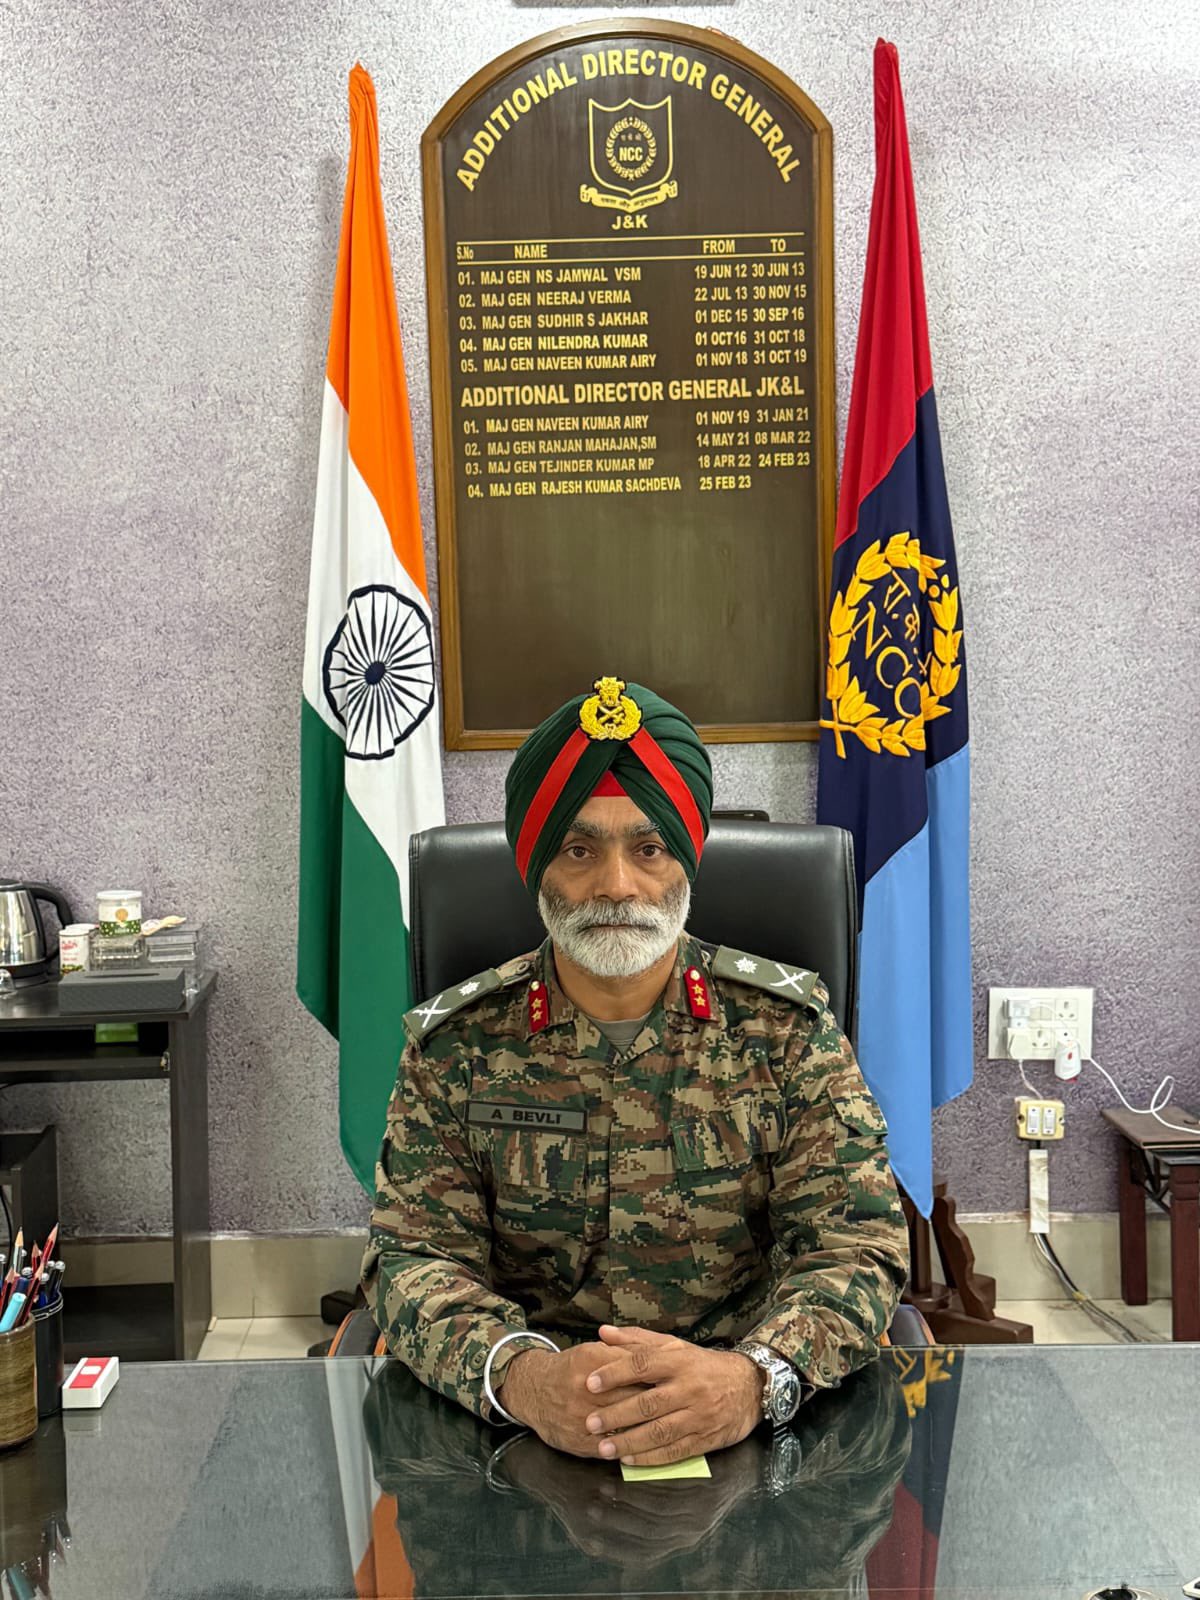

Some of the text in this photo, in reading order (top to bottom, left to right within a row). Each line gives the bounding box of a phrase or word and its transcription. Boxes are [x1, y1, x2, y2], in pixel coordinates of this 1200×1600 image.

[456, 49, 801, 191] ADDITIONAL DIRECTOR GENERAL
[620, 147, 643, 161] NCC
[611, 215, 648, 230] J&K
[514, 245, 548, 259] NAME
[703, 240, 735, 253] FROM
[771, 239, 786, 252] TO
[458, 267, 641, 285] 01. MAJ GEN NS JAMWAL VSM
[695, 262, 805, 279] 19 JUN 12 30 JUN 13
[459, 290, 632, 308] 02. MAJ GEN NEERAJ VERMA
[695, 285, 807, 301] 22 JUL 13 30 NOV 15
[460, 312, 648, 330] 03. MAJ GEN SUDHIR S JAKHAR
[695, 307, 804, 323] 01 DEC 15 30 SEP 16
[460, 334, 648, 352] 04. MAJ GEN NILENDRA KUMAR
[695, 329, 805, 346] 01 OCT 16 31 OCT 18
[461, 354, 656, 372] 05. MAJ GEN NAVEEN KUMAR AIRY
[696, 349, 807, 367] 01 NOV 18 31 OCT 19
[461, 376, 805, 407] ADDITIONAL DIRECTOR GENERAL JK&L
[464, 415, 648, 434] 01. MAJ GEN NAVEEN KUMAR AIRY
[696, 408, 808, 425] 01 NOV 19 31 JAN 21
[465, 443, 480, 456] 02.
[488, 442, 510, 455] MAJ
[513, 441, 535, 454] GEN
[539, 439, 582, 453] RANJAN
[697, 431, 811, 447] 14 MAY 21 08 MAR 22
[466, 458, 654, 475] 03. MAJ GEN TEJINDER KUMAR MP
[698, 452, 810, 468] 18 APR 22 24 FEB 23
[468, 477, 681, 498] 04. MAJ GEN RAJESH KUMAR SACHDEVA
[700, 475, 751, 490] 25 FEB 23
[491, 1109, 562, 1124] A BEVLI
